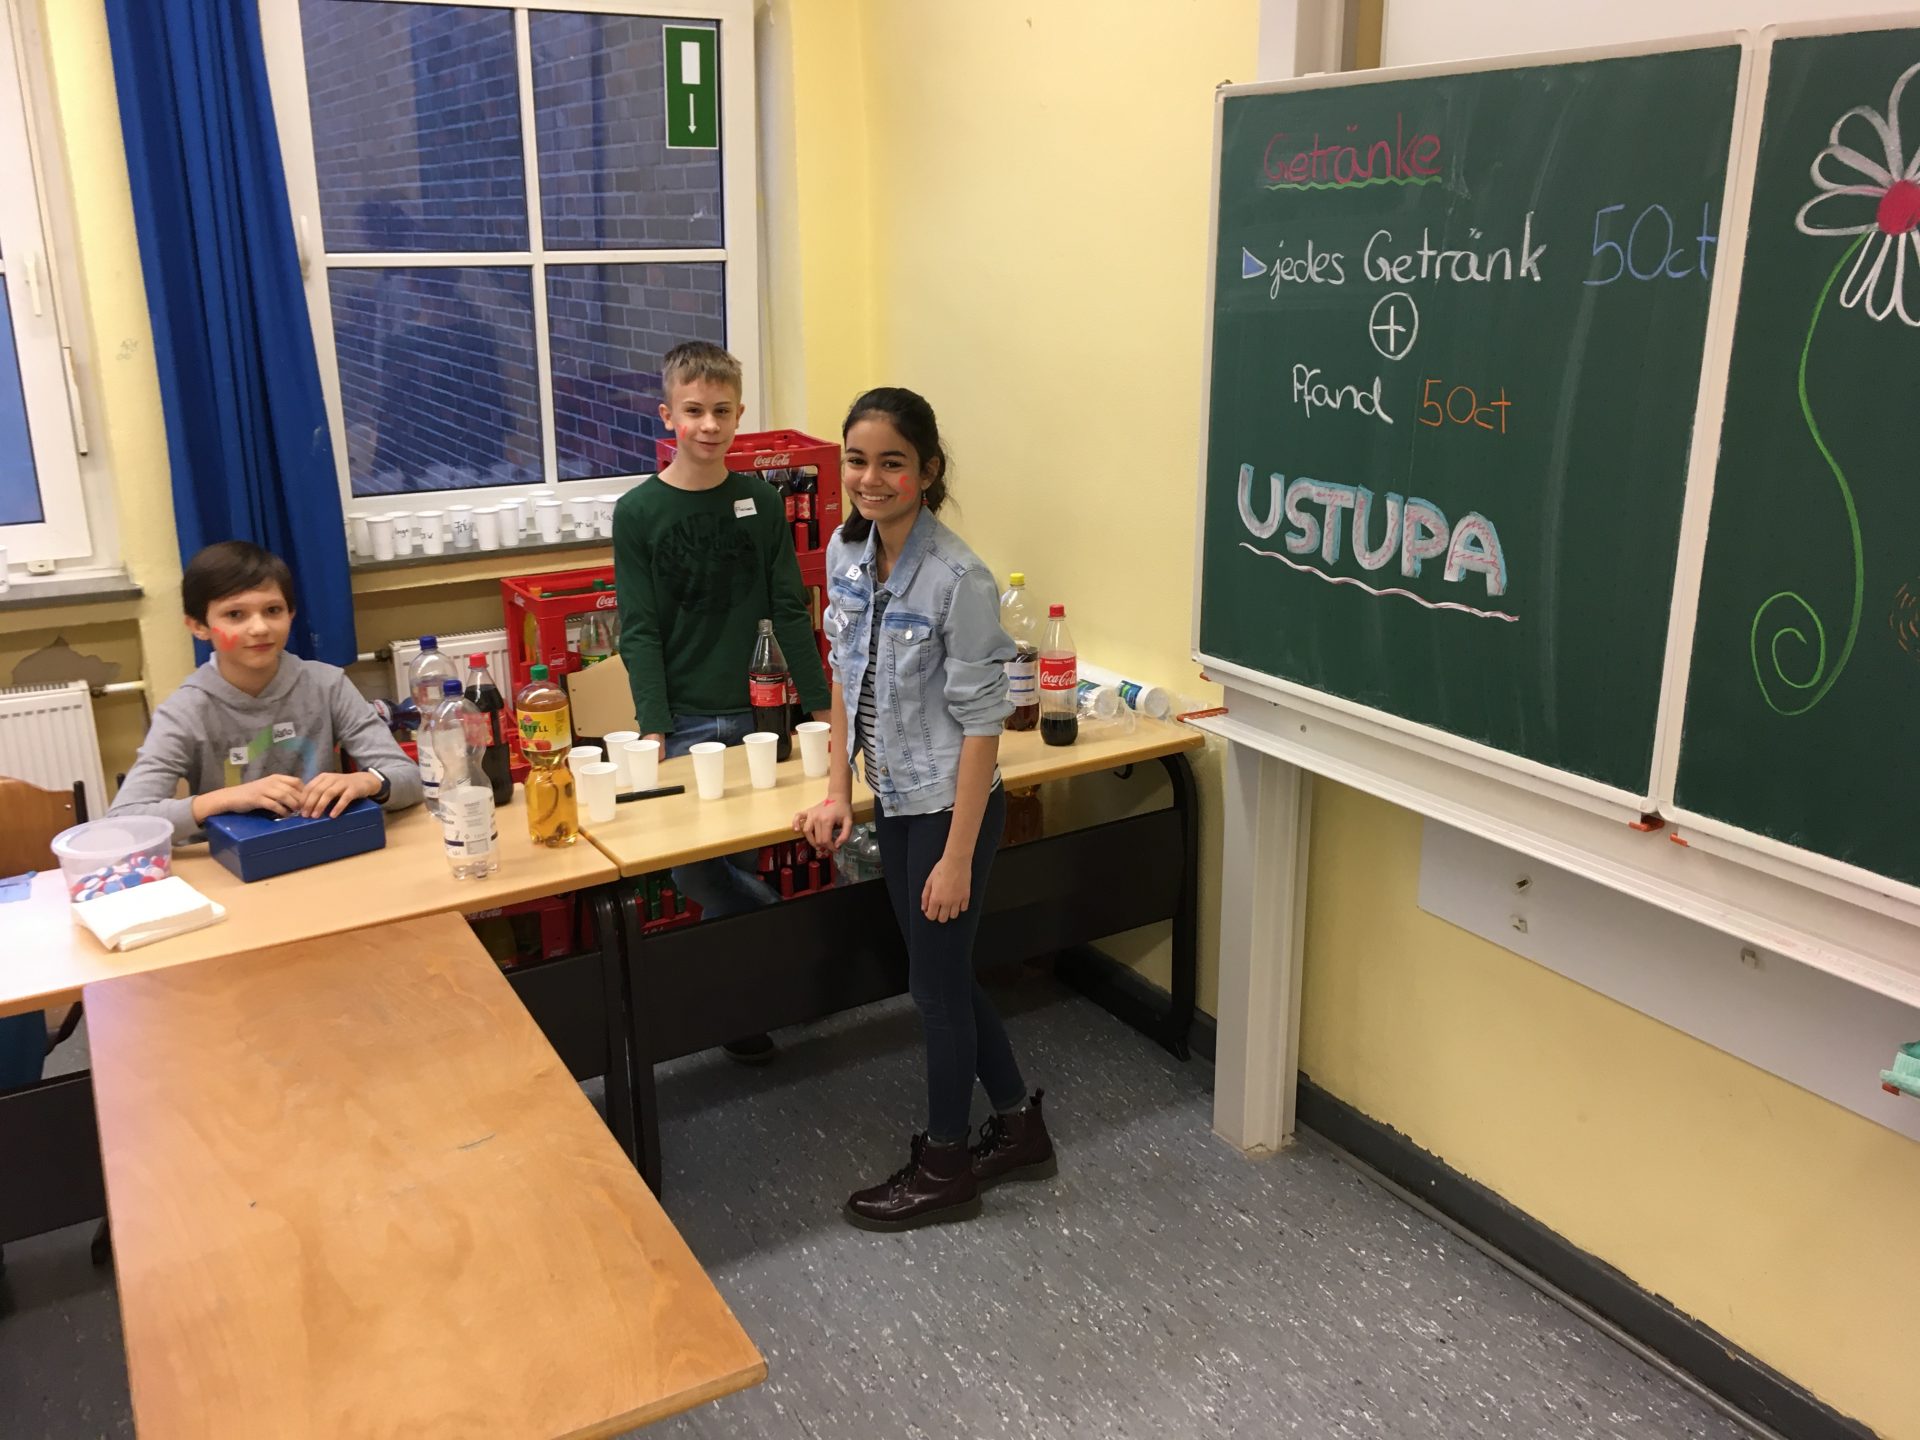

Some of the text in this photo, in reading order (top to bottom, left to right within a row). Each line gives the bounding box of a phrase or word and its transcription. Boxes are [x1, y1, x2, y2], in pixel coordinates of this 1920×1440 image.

[1263, 111, 1442, 185] Getränke
[1270, 201, 1719, 300] jedes Getränk 50ct
[1292, 364, 1511, 434] Pfand 50ct
[1237, 463, 1508, 598] USTUPA
